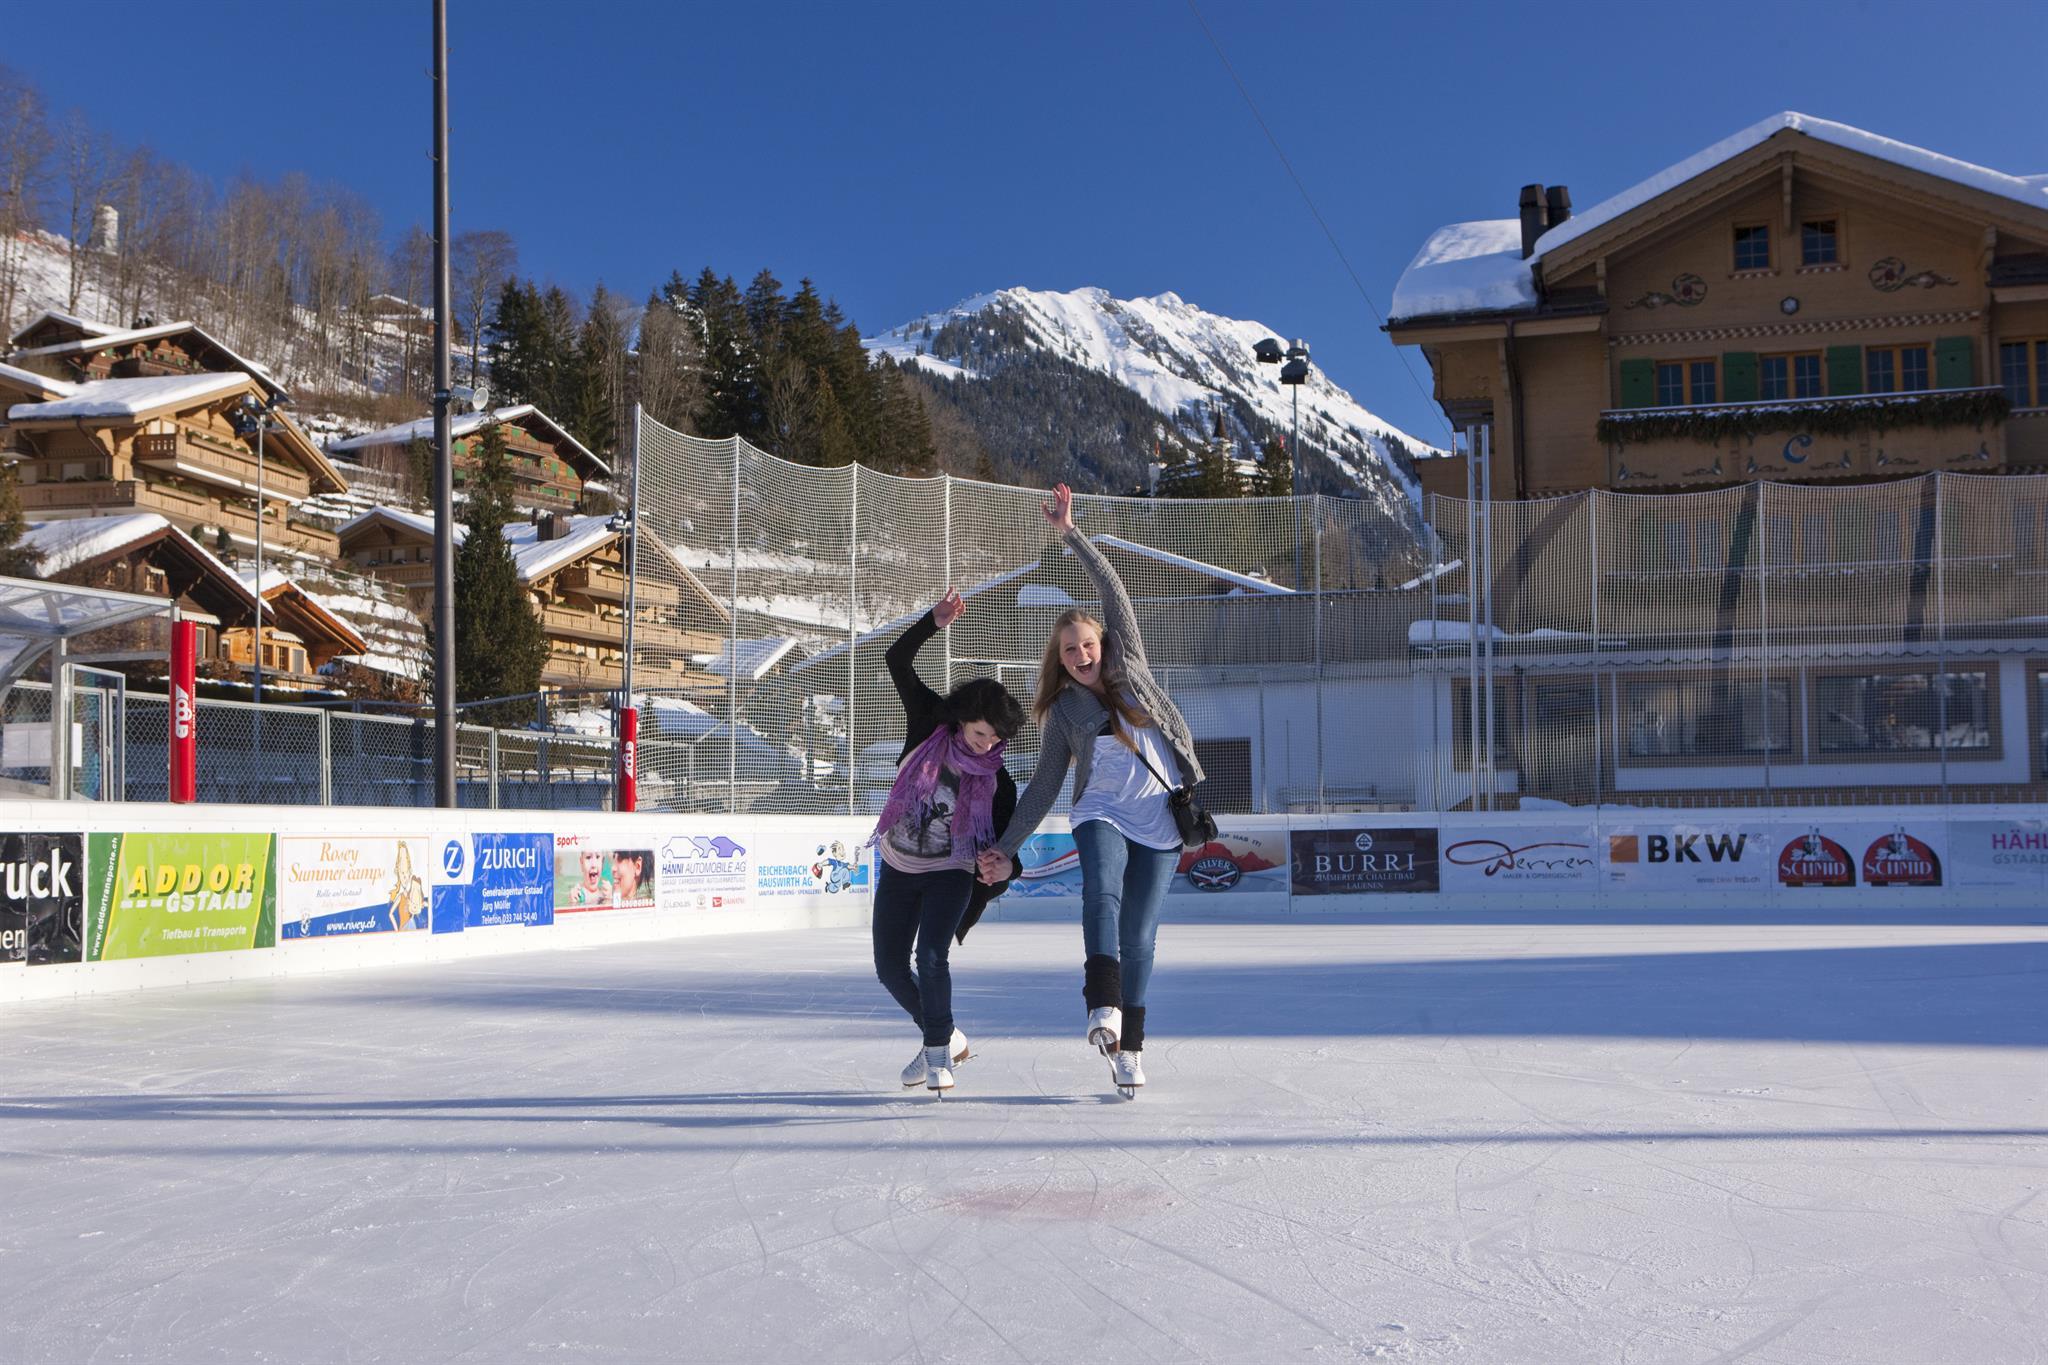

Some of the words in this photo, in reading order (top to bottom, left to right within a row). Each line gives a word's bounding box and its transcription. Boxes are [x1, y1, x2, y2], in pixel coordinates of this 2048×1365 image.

[556, 834, 578, 848] sport
[1647, 834, 1748, 863] BKW
[320, 841, 359, 865] Rosey
[446, 846, 462, 873] Z
[482, 847, 536, 870] ZURICH
[1992, 854, 2048, 864] GSTAAD
[662, 860, 684, 874] HÄNNI
[685, 862, 733, 874] AUTOMOBILE
[735, 861, 746, 872] AG
[758, 865, 807, 876] REICHENBACH
[1197, 859, 1231, 871] SILVER
[1314, 853, 1415, 873] BURRI
[1781, 862, 1846, 876] SCHMID
[1865, 861, 1932, 875] SCHMID
[0, 848, 73, 899] uck
[127, 863, 255, 897] ADDOR
[288, 862, 345, 882] Summer
[758, 877, 800, 888] HAUSWIRTH
[802, 877, 813, 886] AG
[92, 837, 118, 956] www.addortransporte.ch
[482, 886, 523, 898] Generalagentur
[524, 885, 543, 895] Gstaad
[166, 889, 253, 913] GSTAAD
[482, 914, 502, 924] Telefon
[0, 929, 25, 950] en
[162, 928, 193, 940] Tiefbau
[194, 928, 200, 937] &
[202, 925, 247, 938] Transporte
